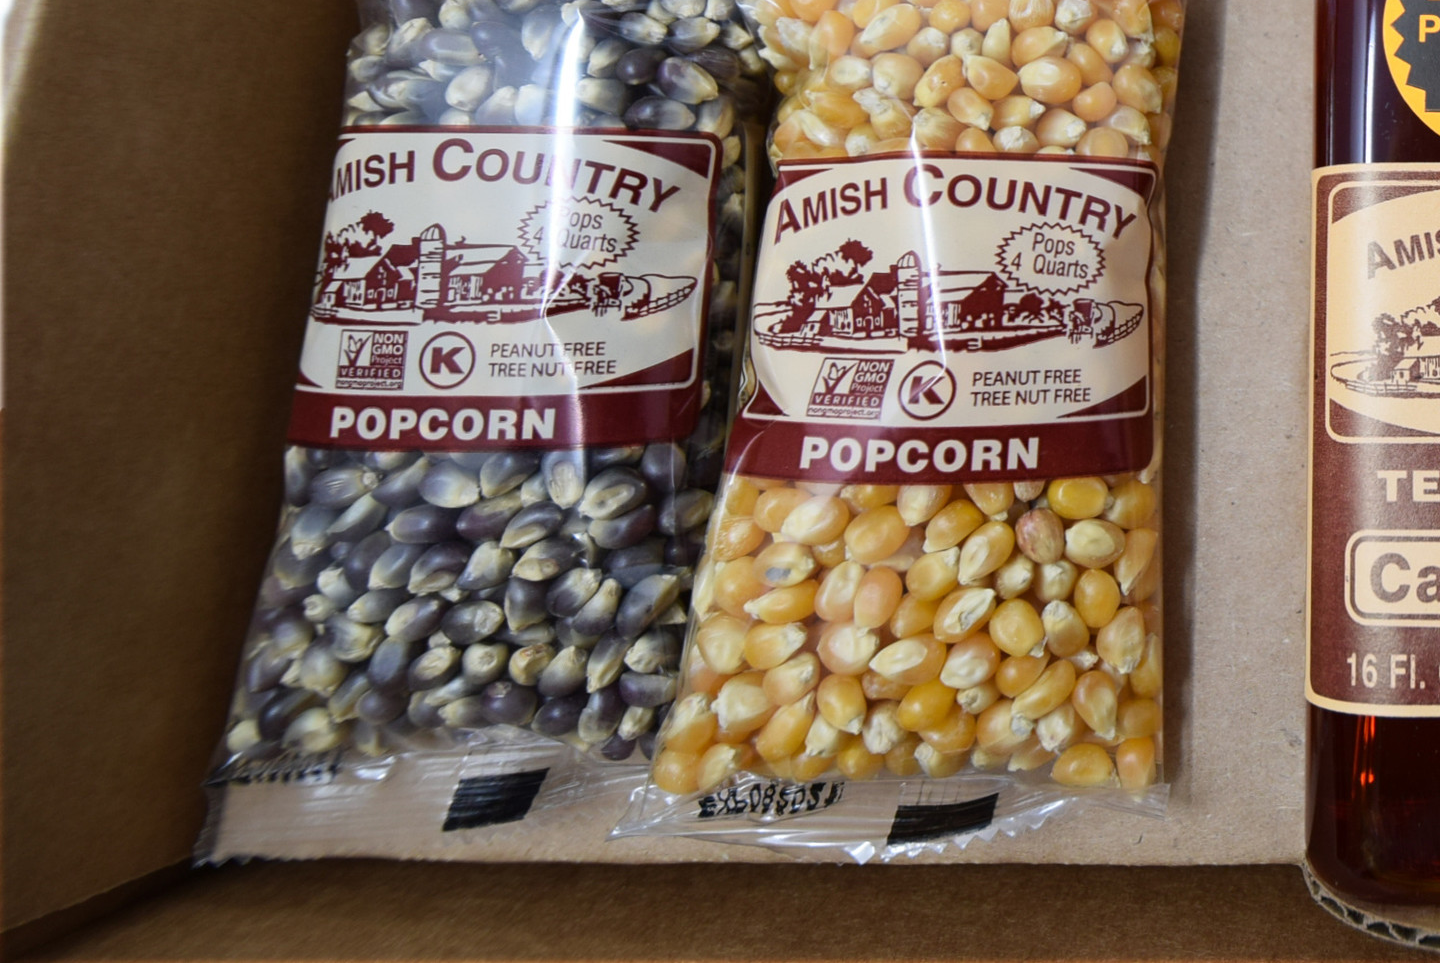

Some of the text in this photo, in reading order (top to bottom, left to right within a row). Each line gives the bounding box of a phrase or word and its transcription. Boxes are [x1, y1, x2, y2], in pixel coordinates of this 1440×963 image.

[329, 150, 415, 203] MISH
[774, 164, 1137, 246] AMISH COUNTRY
[532, 227, 544, 245] 4
[1032, 232, 1074, 256] Pops
[1010, 254, 1089, 279] 4 Quarts
[374, 333, 404, 344] NON
[372, 344, 403, 355] GMO
[490, 342, 606, 358] PEANUT FREE
[430, 346, 466, 374] K
[488, 360, 617, 378] TREE NUT FREE
[858, 362, 889, 372] NON
[341, 368, 401, 378] VERIFIED
[854, 372, 887, 383] GMO
[972, 369, 1082, 386] PEANUT FREE
[814, 396, 880, 406] VERIFIED
[970, 388, 1091, 406] TREE NUT FREE
[330, 406, 556, 440] POPCORN
[799, 436, 1040, 473] POPCORN
[1347, 652, 1378, 689] 16
